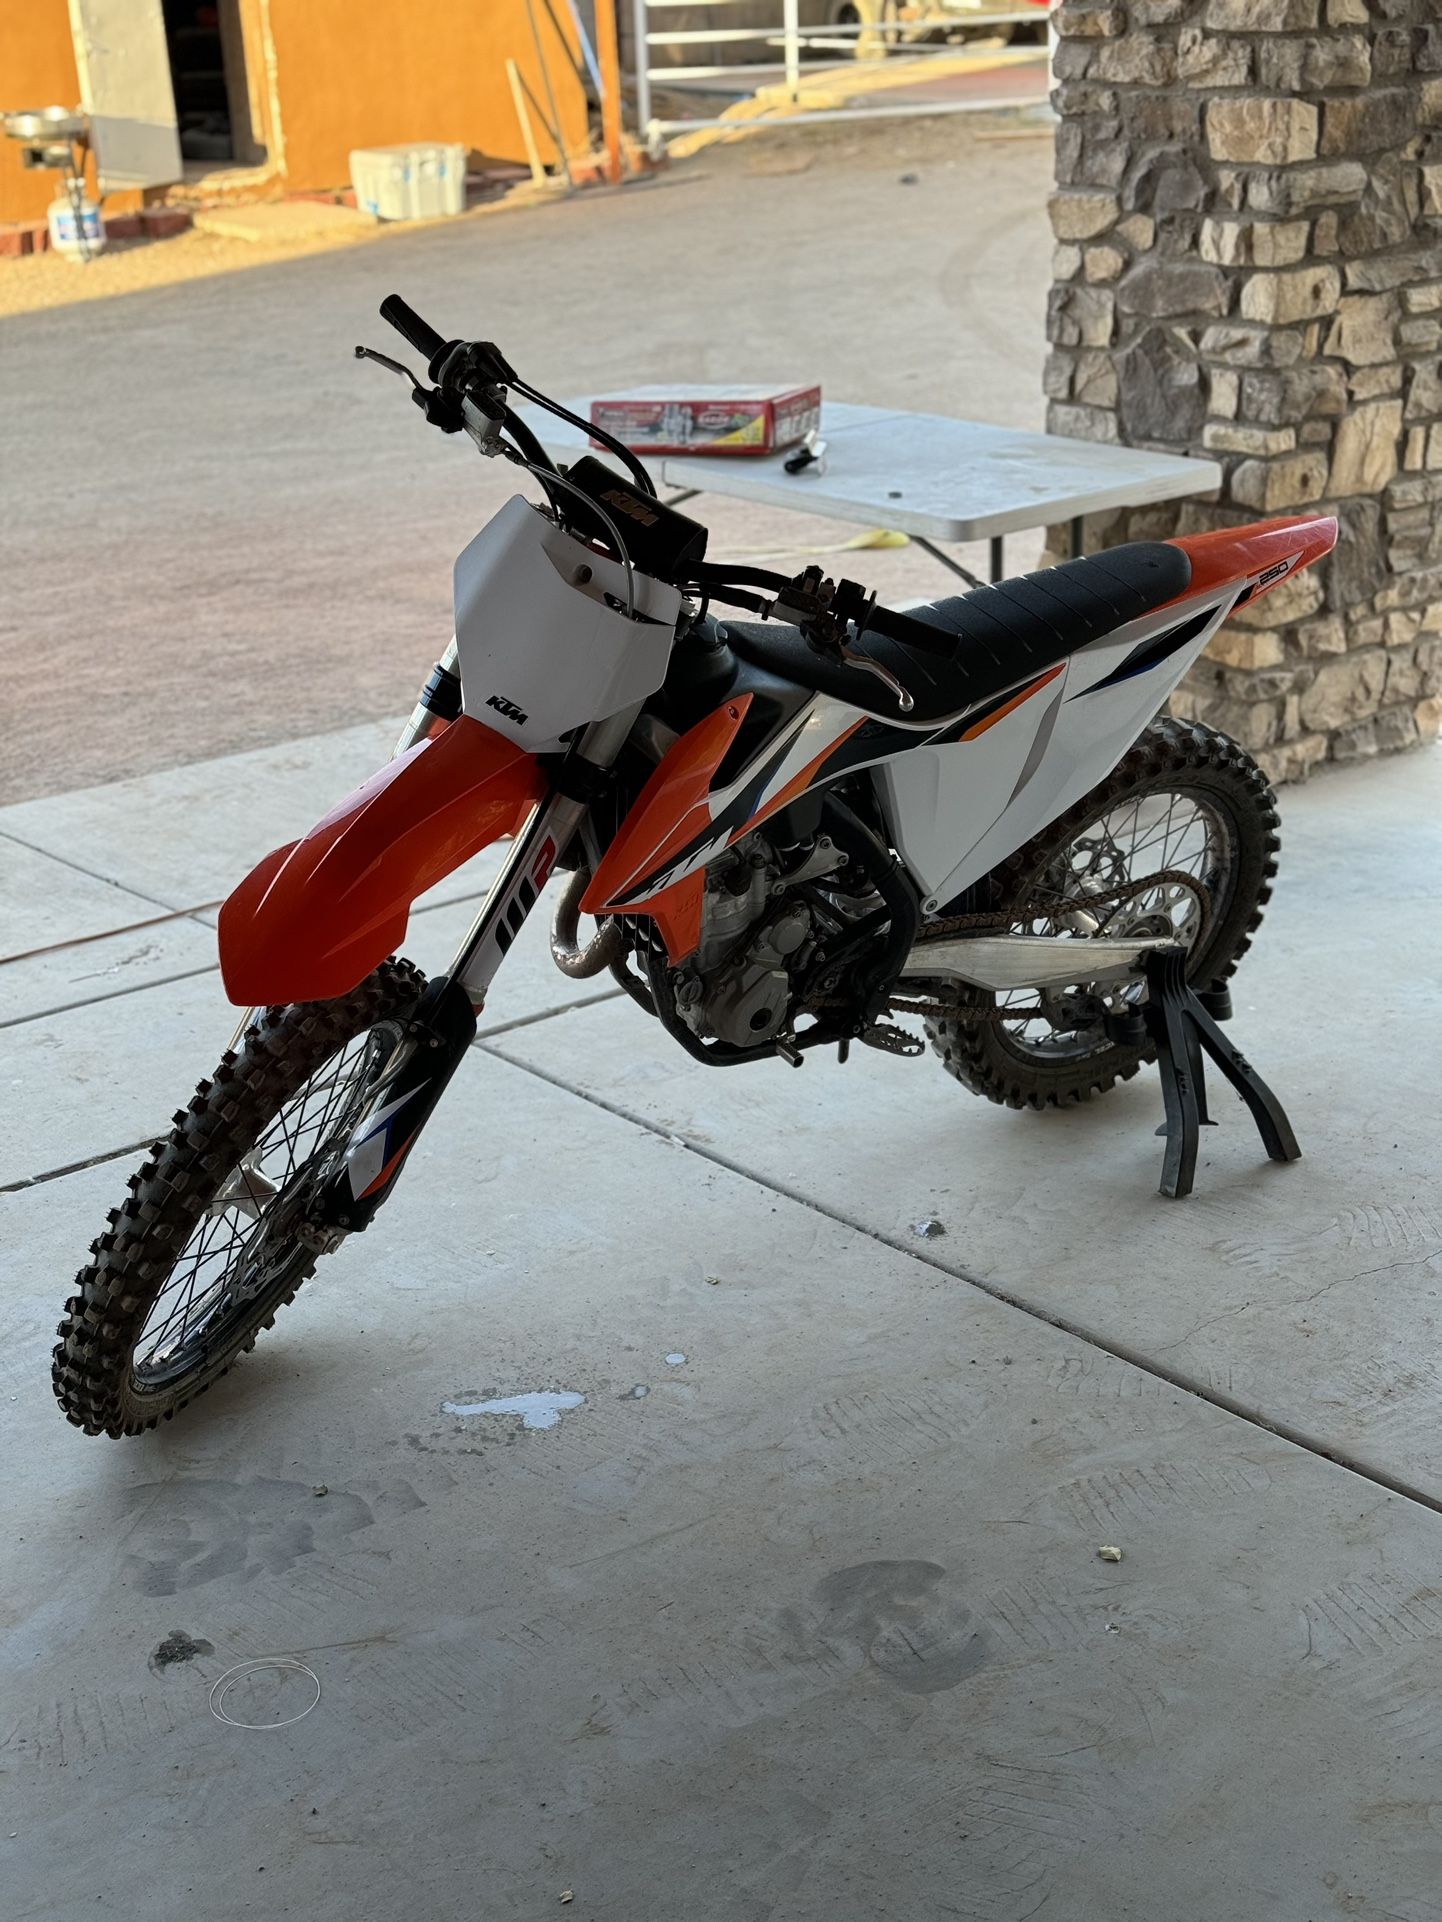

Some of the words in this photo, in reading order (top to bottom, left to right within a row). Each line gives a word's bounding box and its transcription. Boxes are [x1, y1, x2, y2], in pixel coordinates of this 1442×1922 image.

[599, 489, 660, 527] KTM
[1259, 561, 1289, 585] 250
[486, 695, 529, 726] KTM
